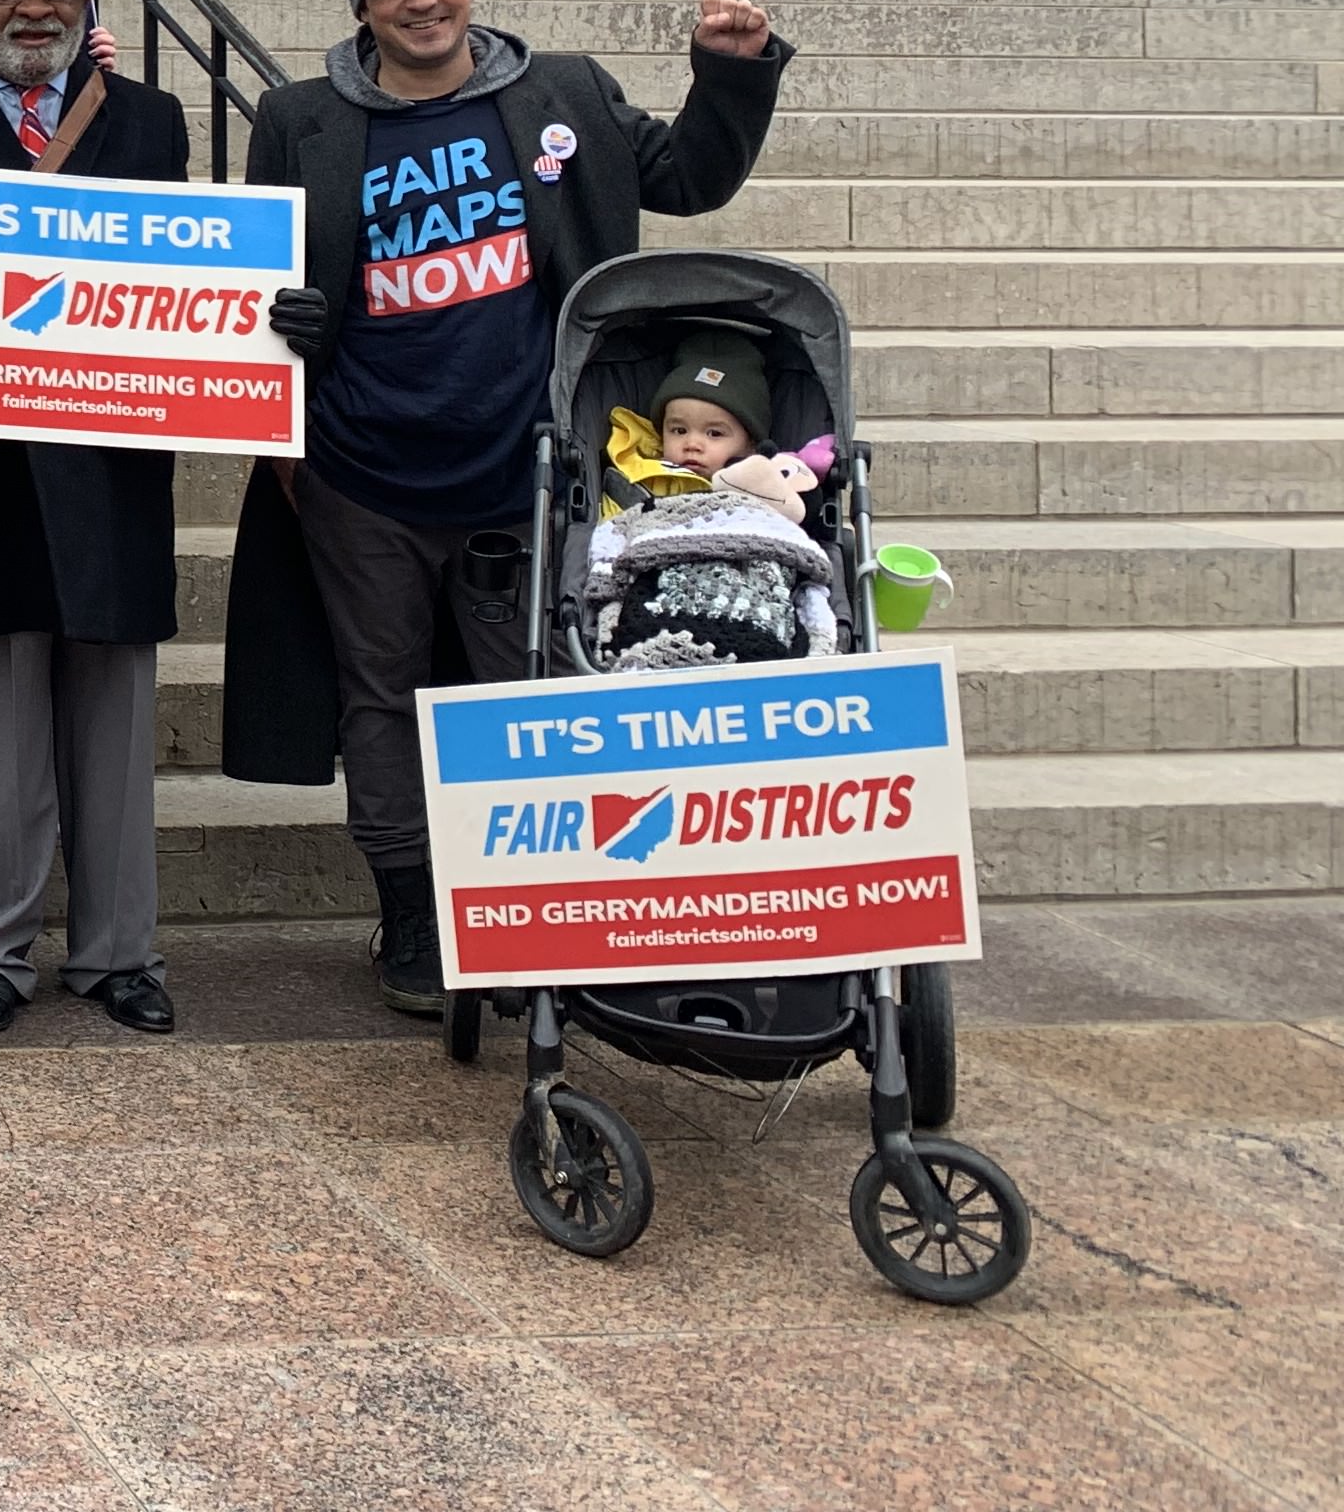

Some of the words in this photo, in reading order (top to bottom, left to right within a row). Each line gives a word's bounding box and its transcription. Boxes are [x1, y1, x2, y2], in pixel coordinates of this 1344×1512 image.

[362, 138, 492, 216] FAIR
[32, 206, 128, 245] TIME
[142, 215, 232, 250] FOR
[368, 180, 527, 261] MAPS
[371, 234, 530, 310] NOW!
[67, 281, 262, 335] DISTRICTS
[2, 393, 167, 421] fairdistrictsohio.org
[204, 377, 283, 400] NOW!
[507, 717, 604, 759] IT'S
[618, 704, 747, 750] TIME
[762, 695, 873, 740] FOR
[483, 795, 585, 856] FAIR
[679, 774, 915, 846] DISTRICTS
[465, 903, 532, 928] END
[542, 886, 848, 924] GERRYMANDERING
[859, 874, 949, 906] NOW!
[607, 923, 817, 948] fairdistrictsohio.org
